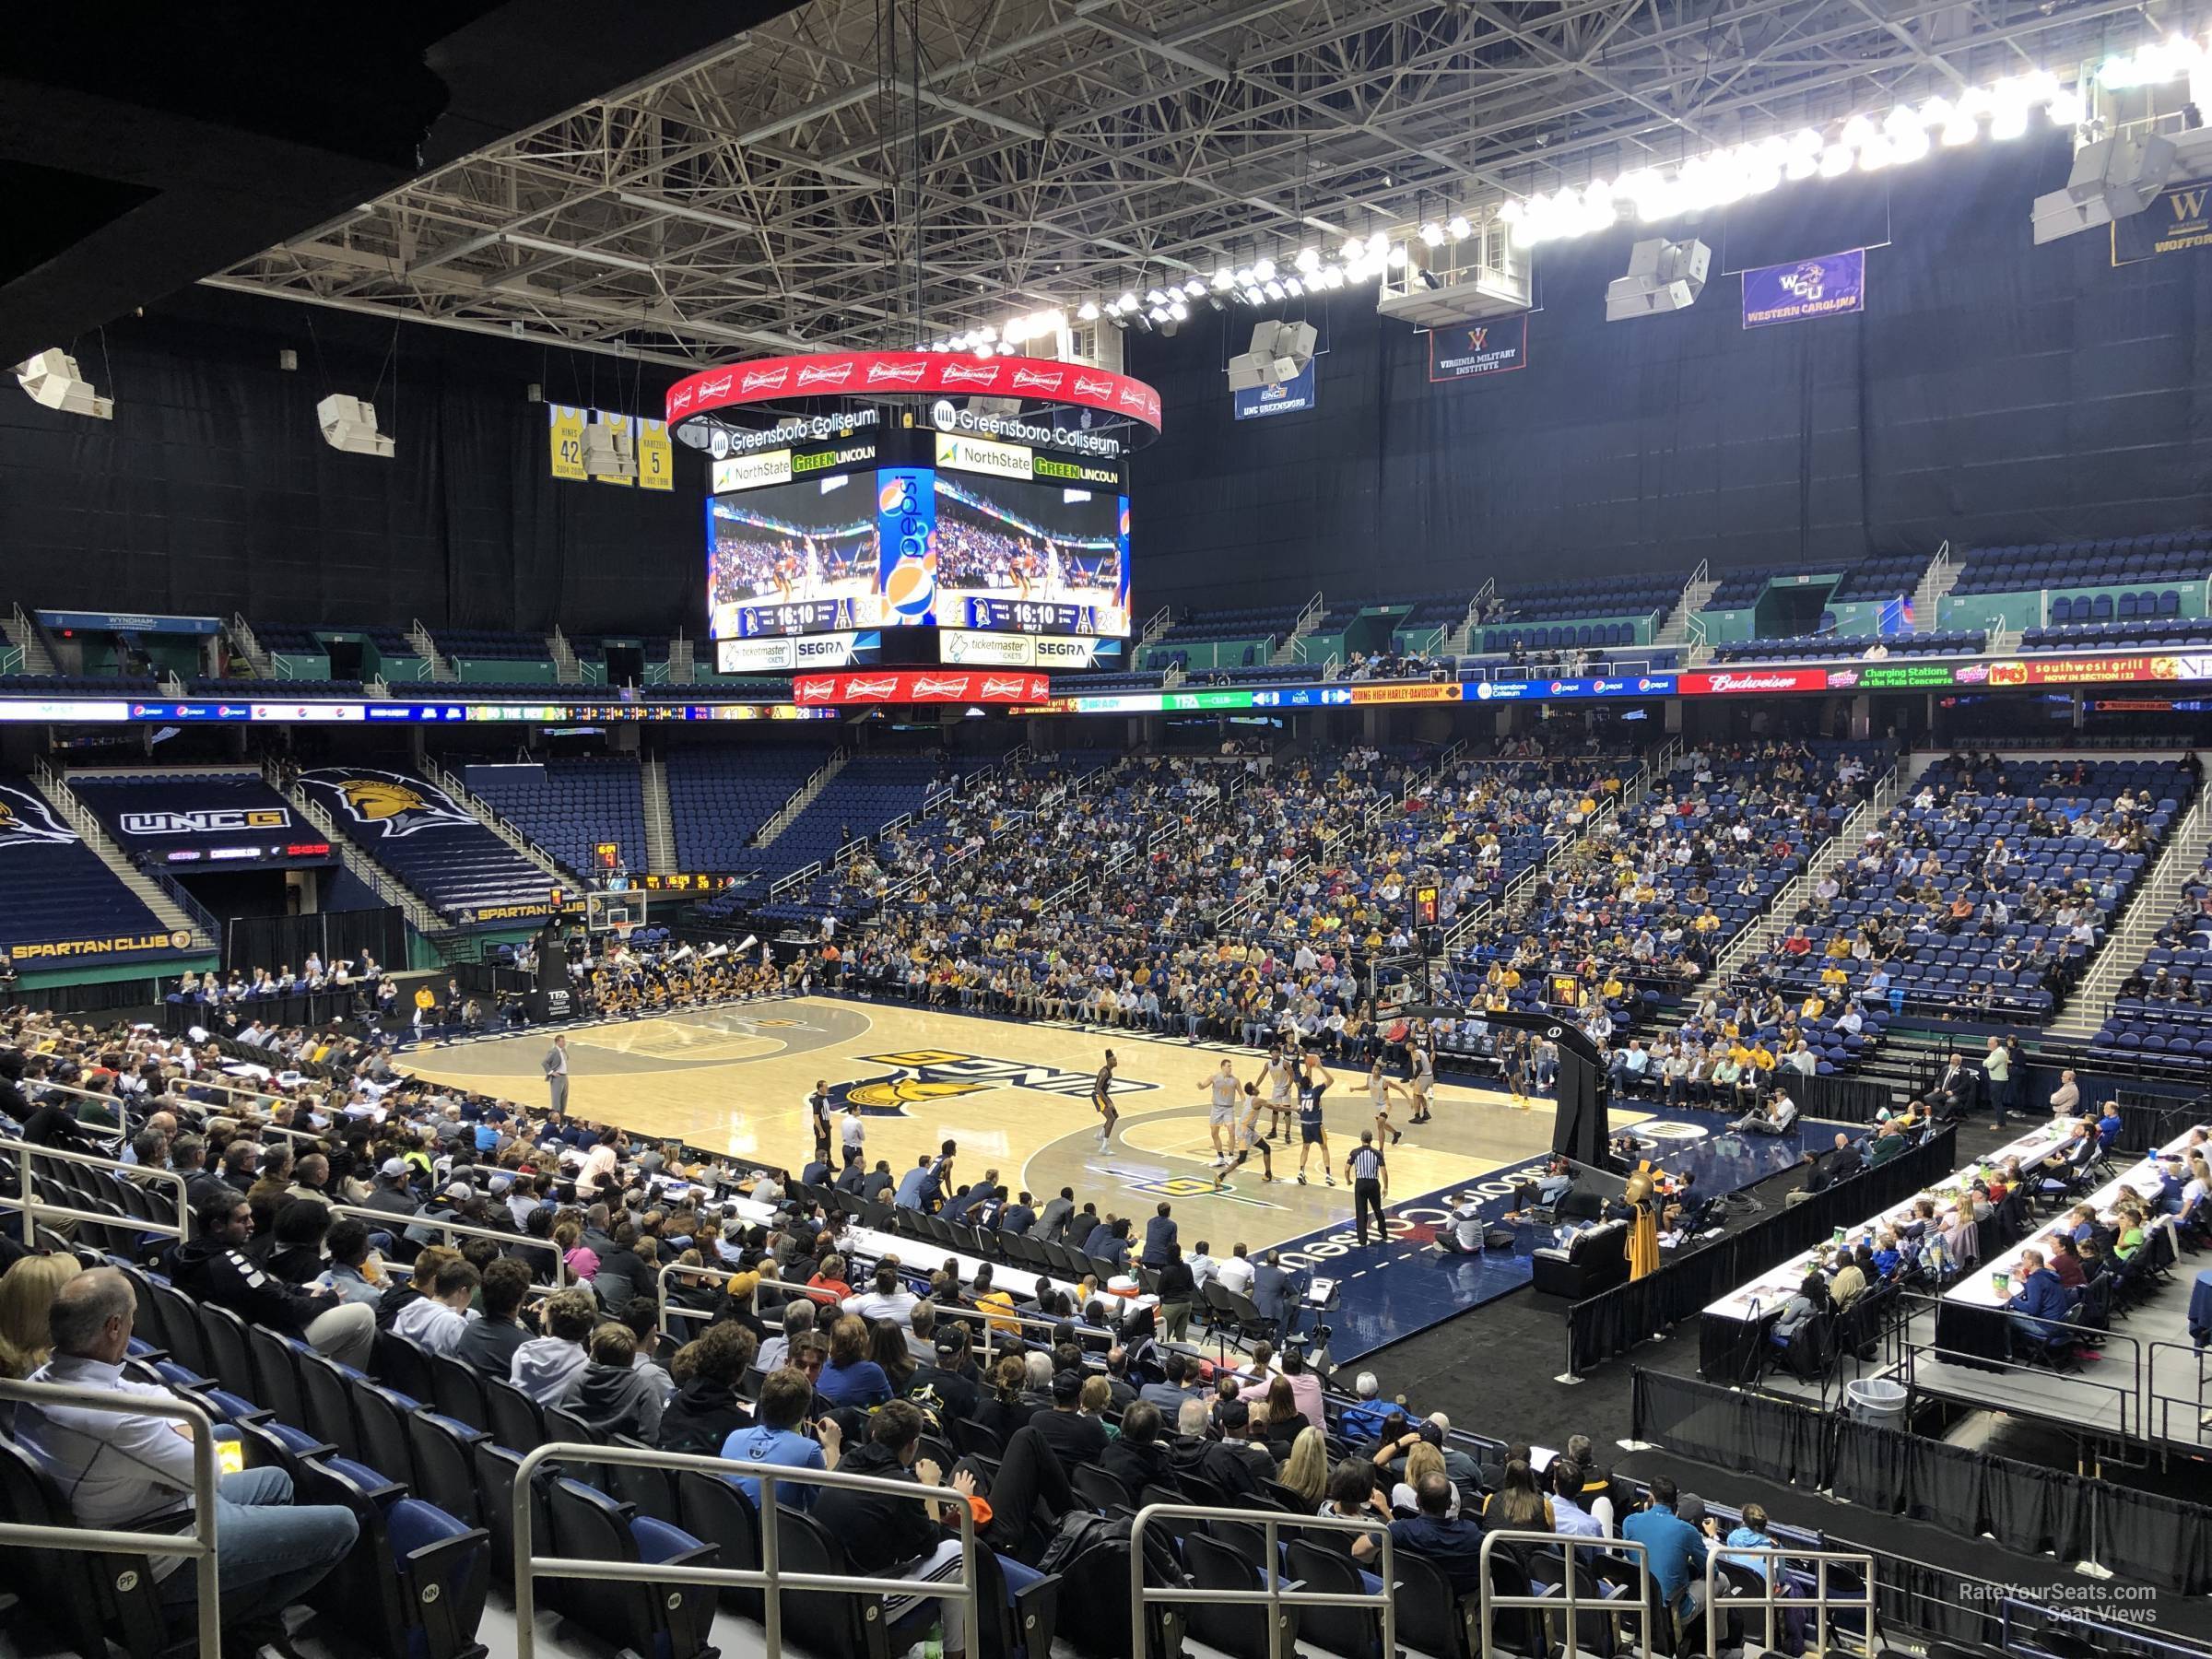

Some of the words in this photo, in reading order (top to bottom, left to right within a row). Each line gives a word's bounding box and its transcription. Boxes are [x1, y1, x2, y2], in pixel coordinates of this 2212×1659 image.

[1747, 305, 1800, 323] WESTERN
[1801, 296, 1856, 314] CAROLINA
[1440, 357, 1476, 370] VIRGINIA
[1477, 348, 1516, 362] MILITARY
[1455, 360, 1500, 375] INSTITUTE
[1243, 406, 1258, 417] UNC
[1259, 398, 1306, 414] GREENSBORO
[731, 424, 808, 451] Greensboro
[812, 408, 876, 435] Coliseum
[959, 409, 1052, 442] Greensboro
[1054, 429, 1120, 453] Coliseum
[560, 441, 580, 464] 42
[792, 451, 836, 473] GREEN
[835, 445, 876, 465] LINCOLN
[652, 453, 660, 474] 5
[964, 448, 1030, 471] NorthState
[735, 462, 790, 481] NorthState
[1033, 457, 1080, 480] GREEN
[1079, 468, 1118, 485] LINCOLN
[895, 476, 923, 558] pepsi
[777, 605, 814, 626] 16:10
[1014, 604, 1054, 624] 16:10
[742, 645, 786, 656] ticketmaster
[798, 641, 844, 655] SEGRA
[971, 640, 1024, 652] ticketmaster
[1038, 642, 1086, 655] SEGRA
[1865, 668, 1906, 679] Charging
[1908, 666, 1948, 677] Stations
[2035, 662, 2107, 674] southwest
[2112, 659, 2144, 672] grill
[1709, 675, 1796, 691] Budweiser
[1871, 677, 1885, 686] the
[1887, 677, 1908, 686] Main
[1909, 677, 1953, 685] Concourse
[2076, 673, 2119, 681] SECTION
[1492, 683, 1527, 691] Greensboro
[1650, 681, 1669, 689] pepsi
[1372, 689, 1386, 700] HIGH
[1052, 698, 1065, 707] grill
[146, 708, 163, 716] pepsi
[188, 708, 206, 716] pepsi
[614, 709, 623, 717] 14
[639, 709, 647, 717] 21
[663, 709, 672, 717] 44
[724, 708, 738, 719] 41
[796, 708, 810, 719] 28
[125, 809, 288, 832] UNCG
[598, 845, 616, 853] 16:09
[668, 877, 690, 885] 16:09
[698, 880, 710, 888] 28
[477, 905, 547, 921] SPARTAN
[12, 939, 112, 959] SPARTAN
[114, 934, 169, 952] CLUB
[547, 990, 571, 1000] TFA
[1300, 1099, 1314, 1112] 14
[119, 1575, 135, 1588] PP
[424, 1587, 438, 1599] NN
[867, 1609, 877, 1619] LL
